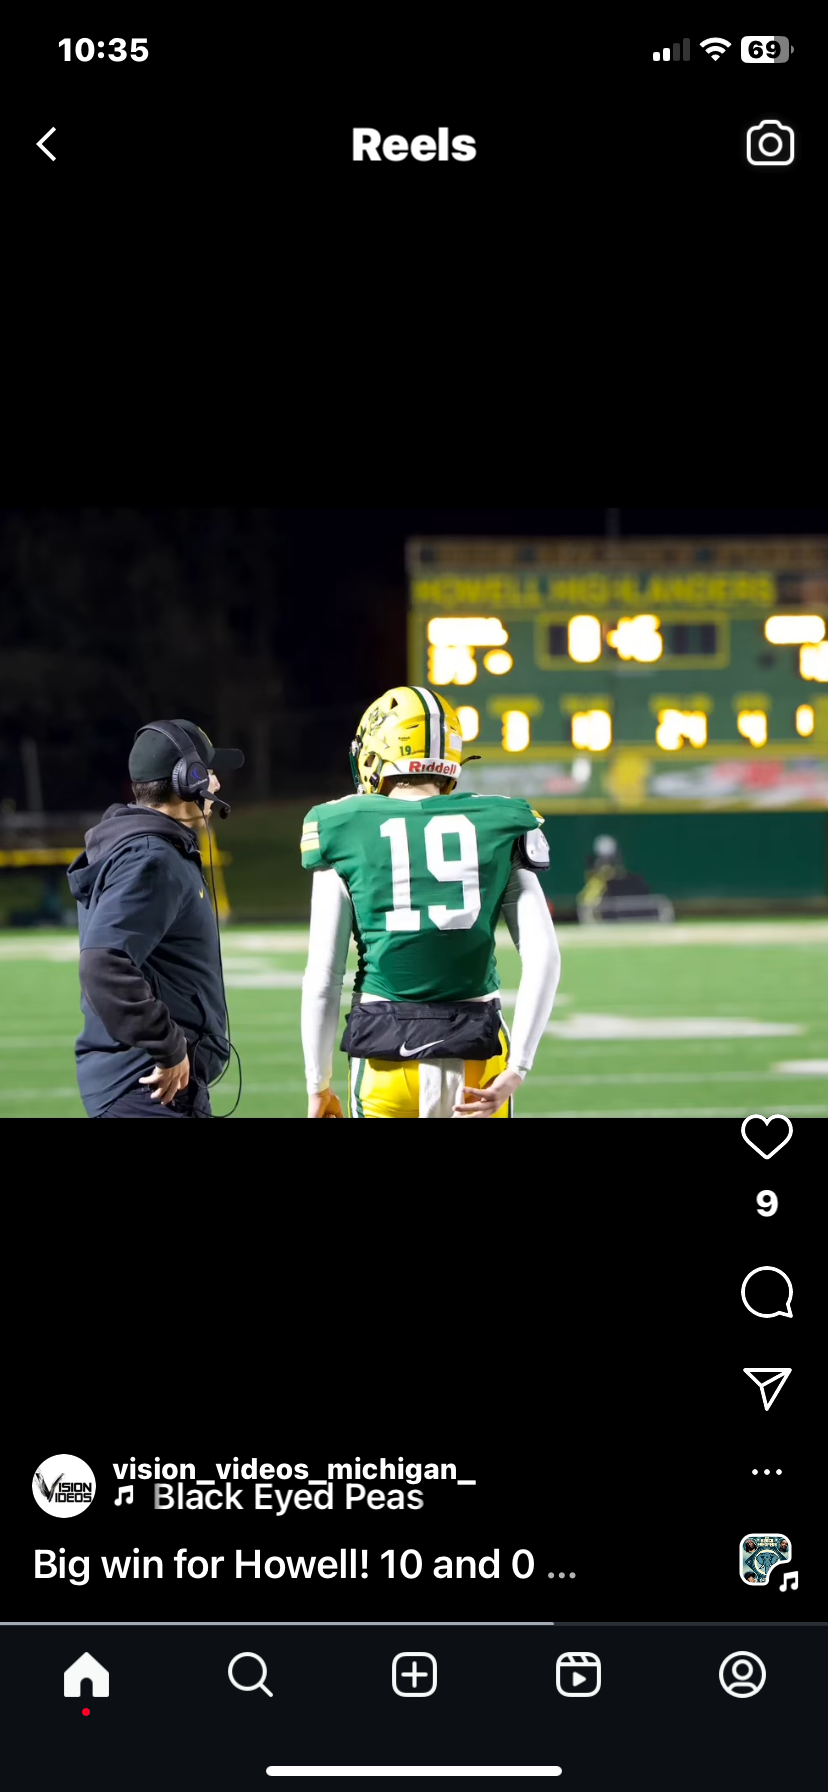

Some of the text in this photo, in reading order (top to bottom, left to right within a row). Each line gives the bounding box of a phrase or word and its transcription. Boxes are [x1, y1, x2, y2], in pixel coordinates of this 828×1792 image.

[399, 745, 411, 756] 19
[409, 761, 457, 775] Riddell
[379, 814, 482, 931] 19
